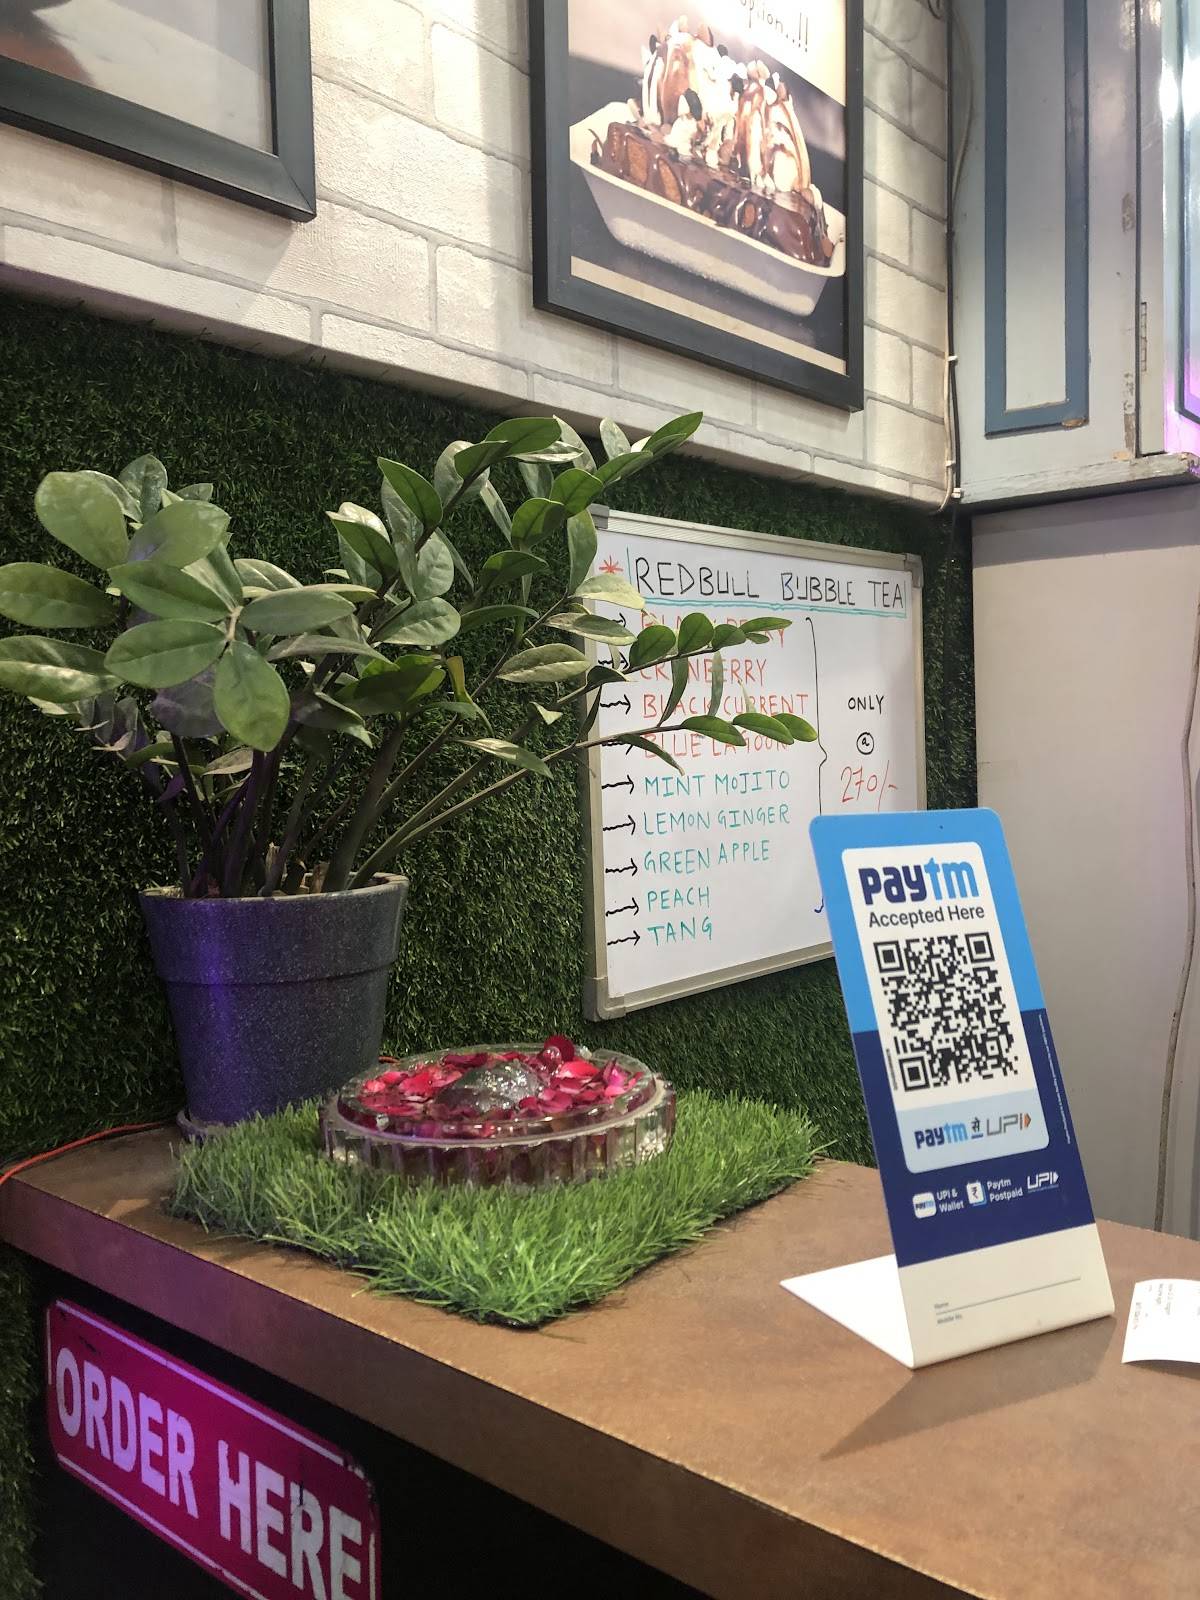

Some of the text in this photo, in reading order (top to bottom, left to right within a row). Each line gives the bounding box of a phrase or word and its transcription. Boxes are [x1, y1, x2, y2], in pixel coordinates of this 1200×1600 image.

[635, 557, 904, 609] REDBULL BUBBLE TEA
[640, 658, 767, 686] CRNBERRY
[848, 694, 885, 715] ONLY
[644, 774, 706, 798] MINT
[643, 803, 791, 835] LEMON GINGER
[644, 839, 771, 875] GREEN APPLE
[647, 886, 711, 912] PEACH
[868, 904, 986, 928] Accepted Here
[647, 916, 714, 947] TANG
[986, 1113, 1024, 1137] UPI
[987, 1178, 1012, 1192] Paytm
[1027, 1171, 1053, 1190] UPI
[938, 1200, 965, 1213] Wallet
[989, 1187, 1024, 1203] Postpaid
[56, 1347, 199, 1520] ORDER
[218, 1439, 363, 1600] HERE
